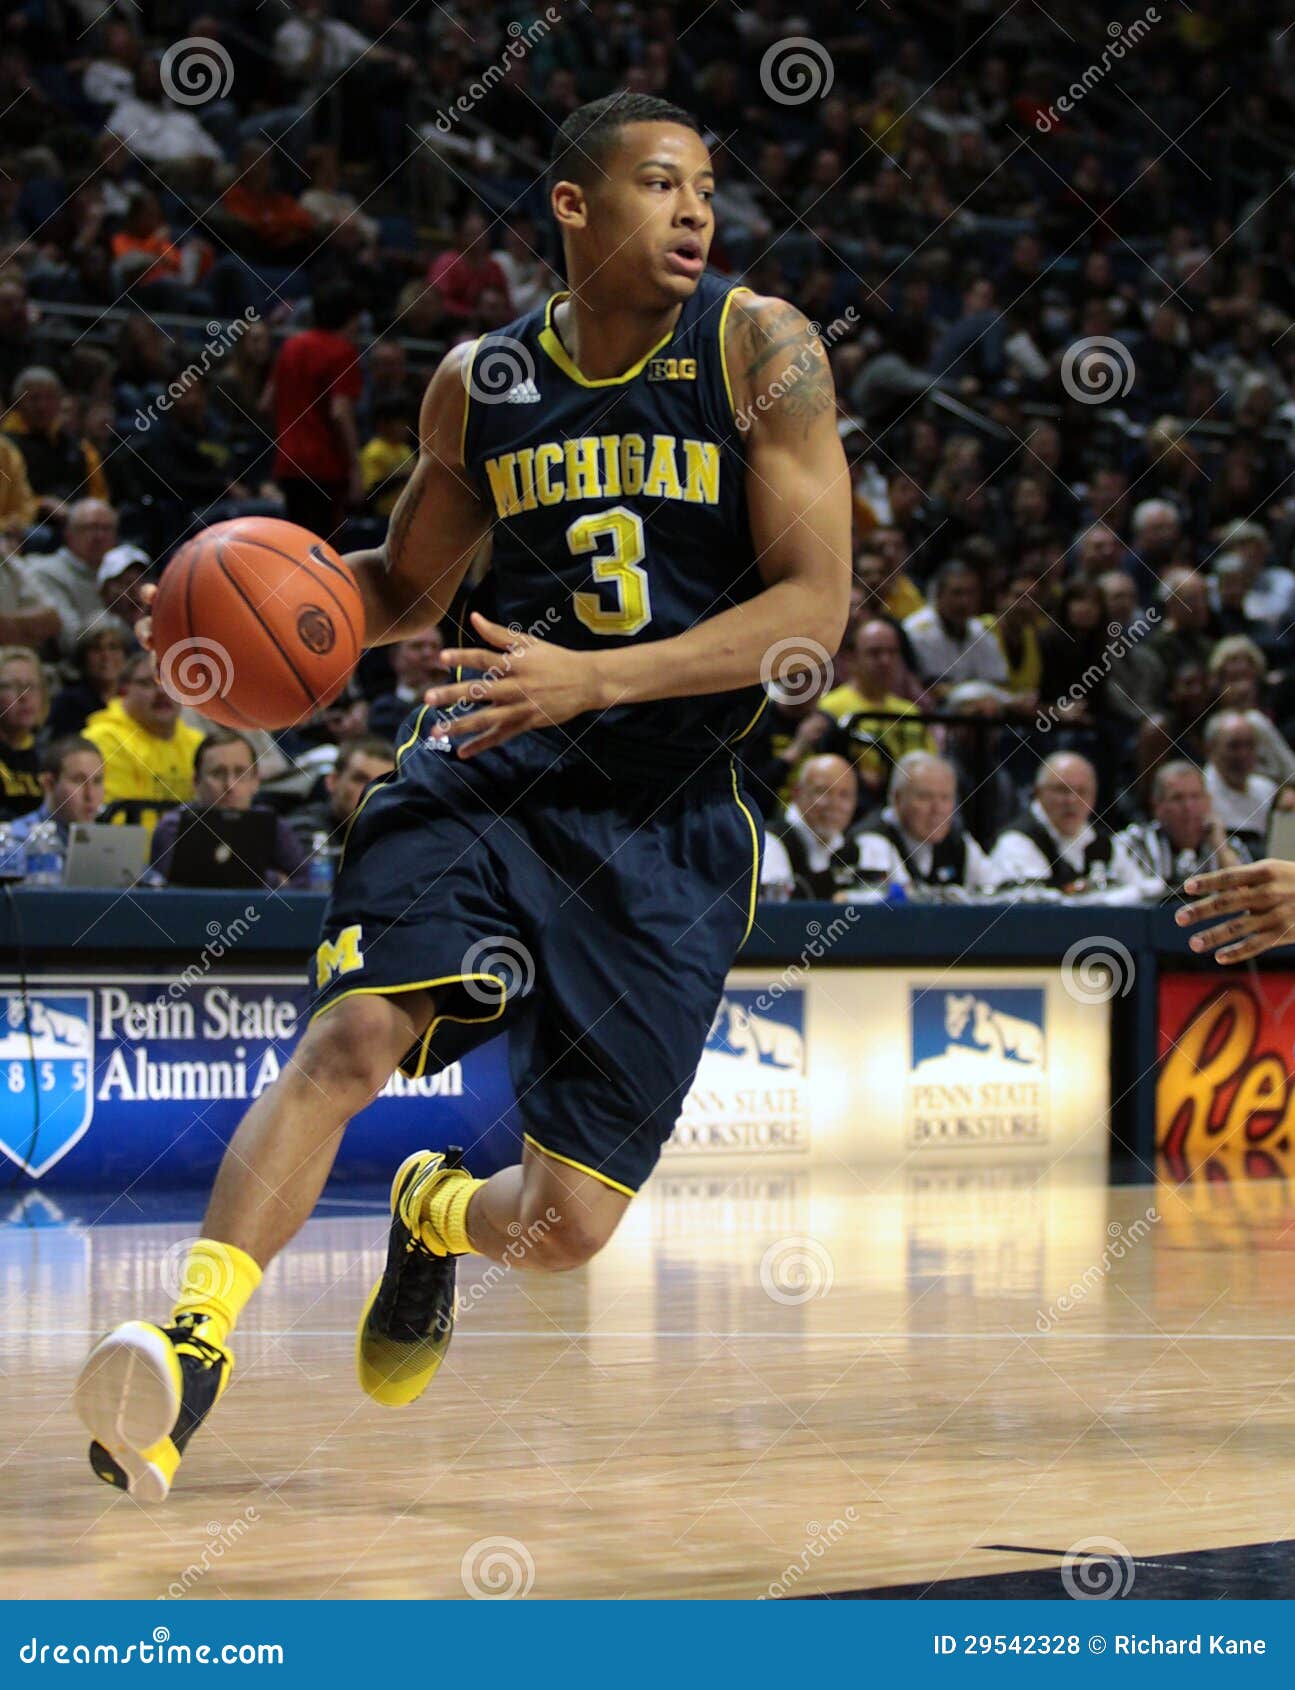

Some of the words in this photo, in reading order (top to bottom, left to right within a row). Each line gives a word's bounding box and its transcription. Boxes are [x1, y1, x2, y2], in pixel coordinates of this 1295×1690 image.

[485, 434, 720, 519] MICHIGAN
[566, 506, 652, 636] 3
[315, 924, 364, 989] M
[100, 987, 195, 1040] Penn
[203, 987, 298, 1040] State
[97, 1046, 246, 1100] Alumni
[912, 1083, 973, 1109] PENN
[979, 1081, 1040, 1107] STATE
[669, 1121, 799, 1146] OOKSTORE
[912, 1114, 1040, 1141] BOOKSTORE
